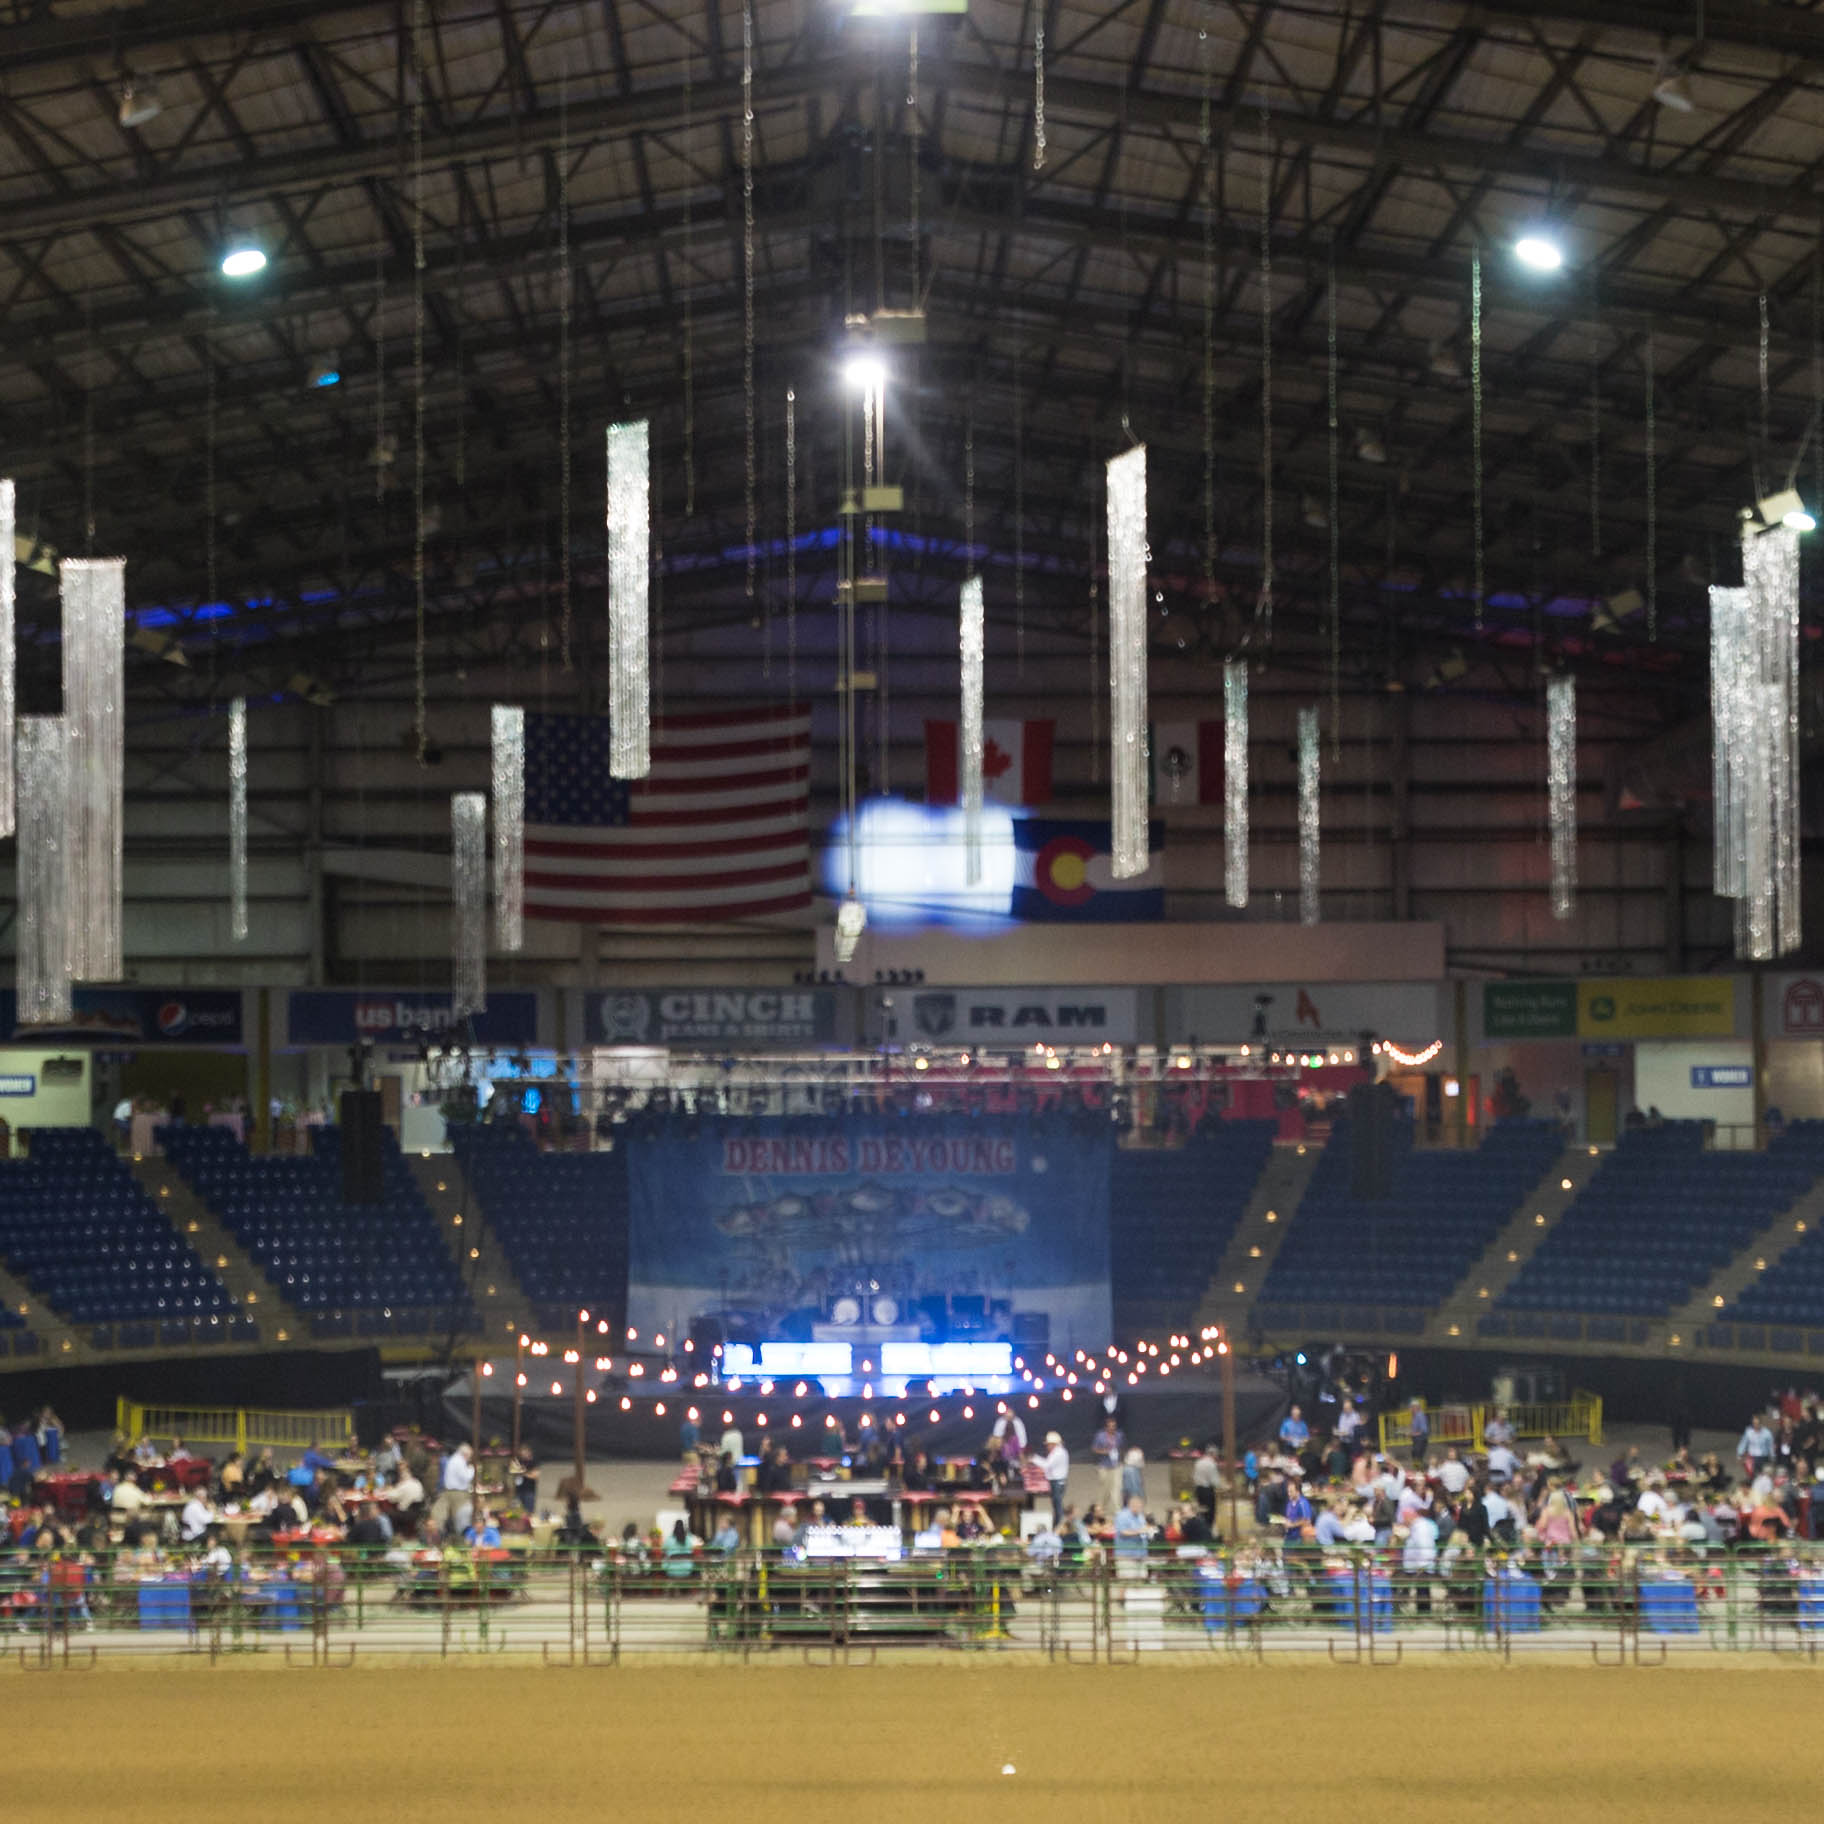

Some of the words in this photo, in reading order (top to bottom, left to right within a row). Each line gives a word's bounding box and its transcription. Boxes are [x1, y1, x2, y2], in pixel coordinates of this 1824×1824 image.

[659, 993, 815, 1021] CINCH
[969, 1005, 1107, 1029] RAM
[724, 1138, 850, 1174] DENNIS
